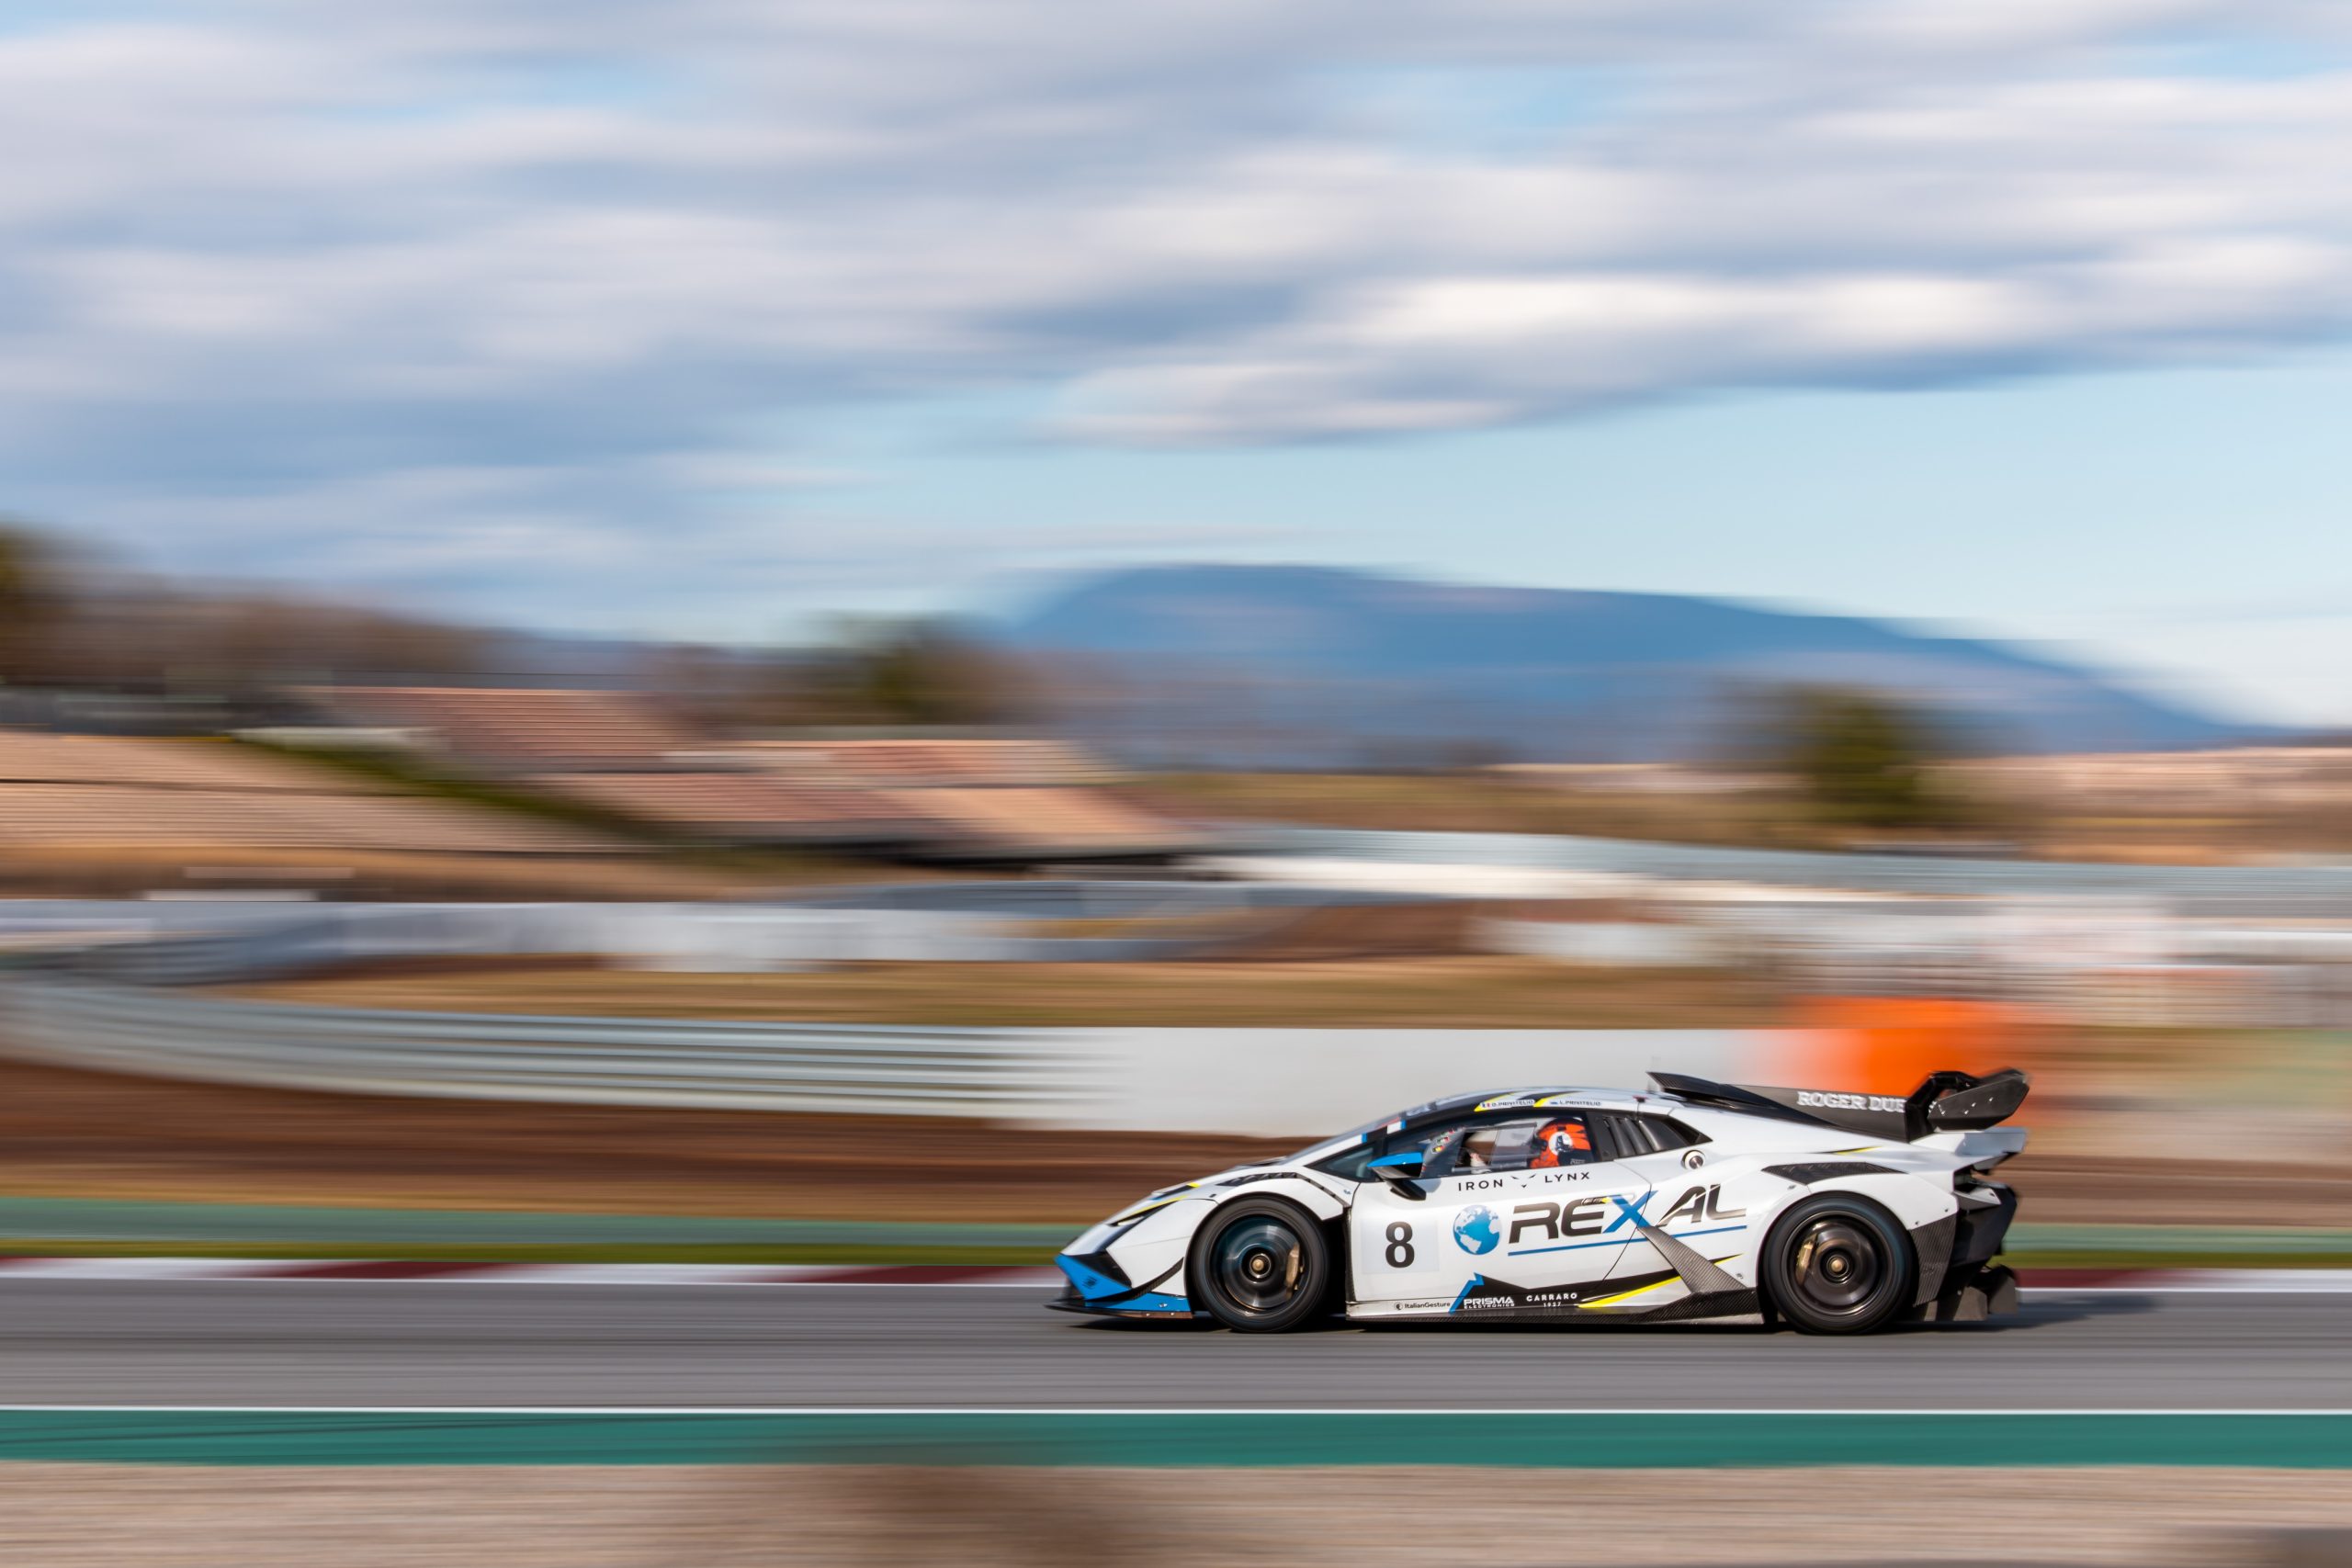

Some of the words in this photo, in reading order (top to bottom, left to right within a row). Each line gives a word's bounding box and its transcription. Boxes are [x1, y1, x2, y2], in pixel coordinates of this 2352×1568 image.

[1796, 1090, 1867, 1111] ROGER
[1458, 1179, 1503, 1191] IRON
[1544, 1171, 1590, 1183] LYNX
[1509, 1183, 1747, 1244] REXAL
[1385, 1221, 1415, 1269] 8
[1464, 1296, 1514, 1305] PRISMA
[1526, 1292, 1577, 1302] CARRARO
